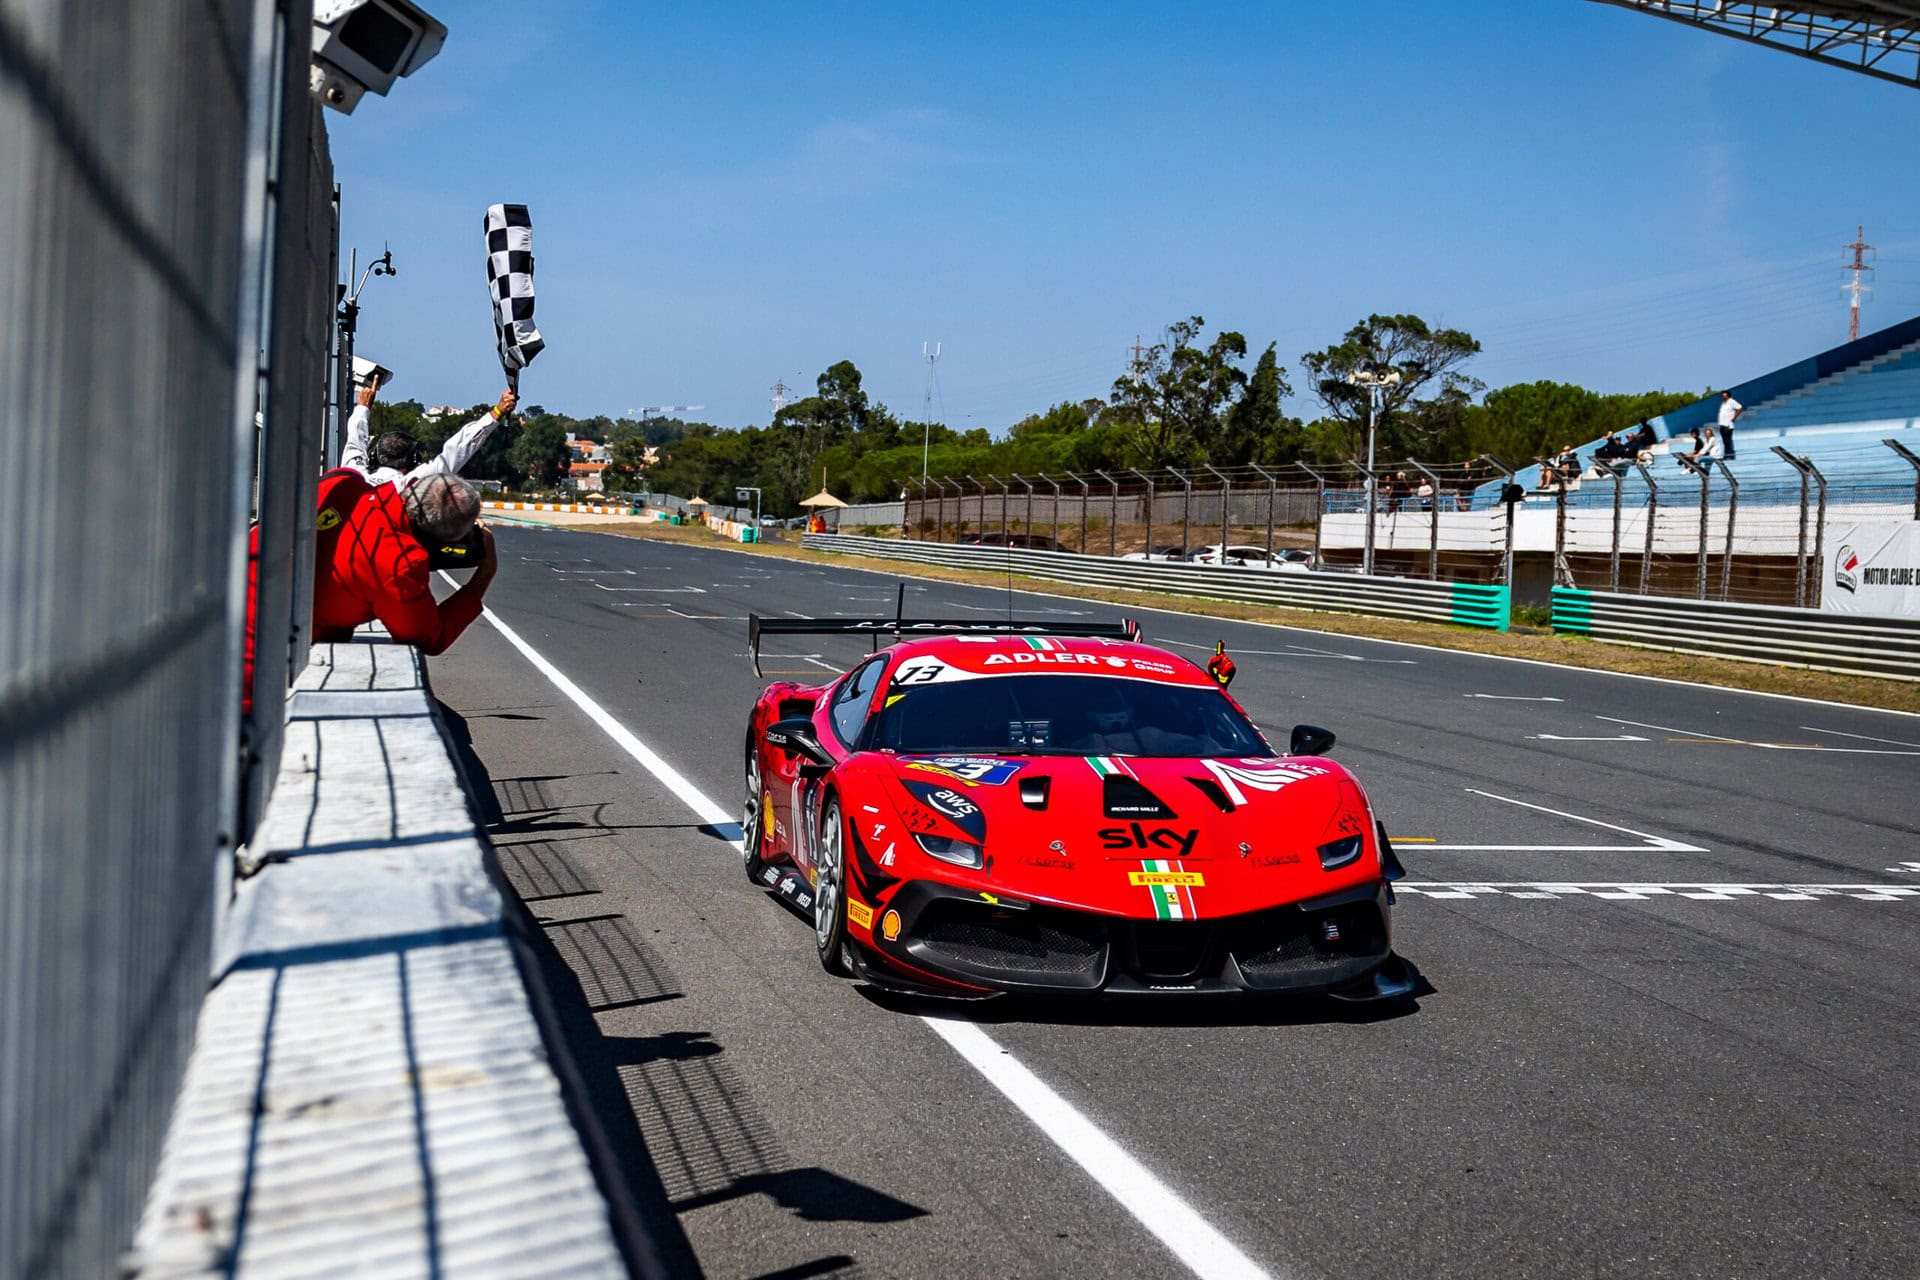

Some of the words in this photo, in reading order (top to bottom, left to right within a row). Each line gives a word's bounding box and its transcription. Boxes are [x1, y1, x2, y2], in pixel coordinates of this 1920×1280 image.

[1863, 567, 1889, 585] MOTOR
[1891, 568, 1914, 586] CLUBE
[984, 652, 1099, 666] ADLER
[901, 665, 944, 684] 73
[934, 789, 979, 814] aws
[1097, 822, 1200, 856] sky
[1137, 874, 1196, 884] PIRELLI
